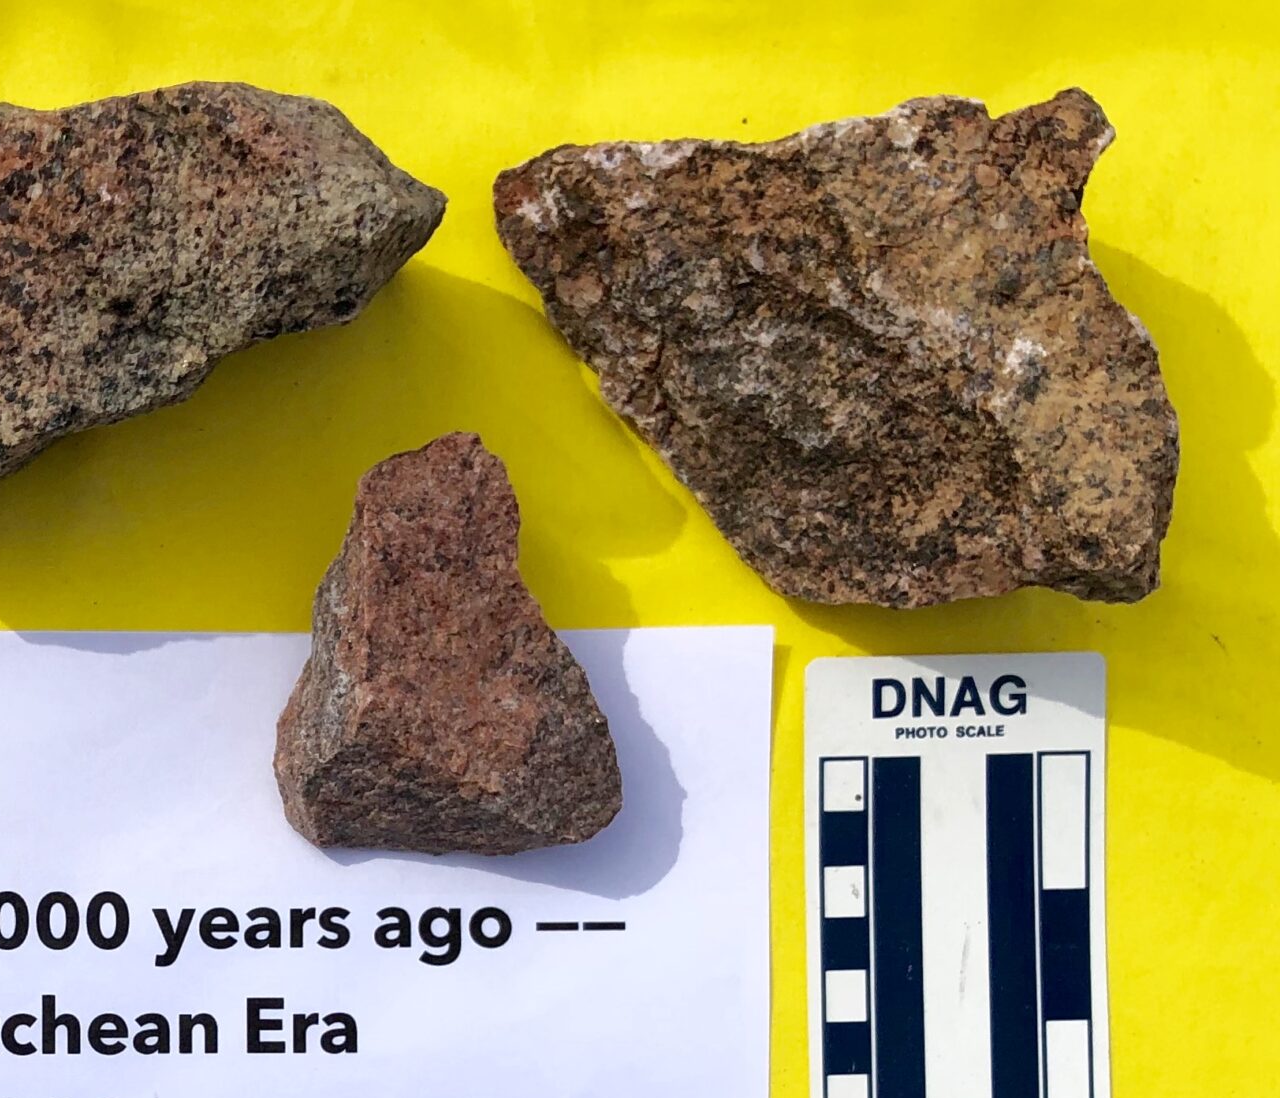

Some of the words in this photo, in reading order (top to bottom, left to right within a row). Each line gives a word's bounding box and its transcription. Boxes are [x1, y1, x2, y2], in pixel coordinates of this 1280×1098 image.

[873, 675, 1027, 718] DNAG
[895, 726, 948, 739] PHOTO
[956, 725, 1005, 738] SCALE
[152, 906, 351, 967] years
[374, 906, 513, 966] ago
[246, 997, 358, 1055] Era
